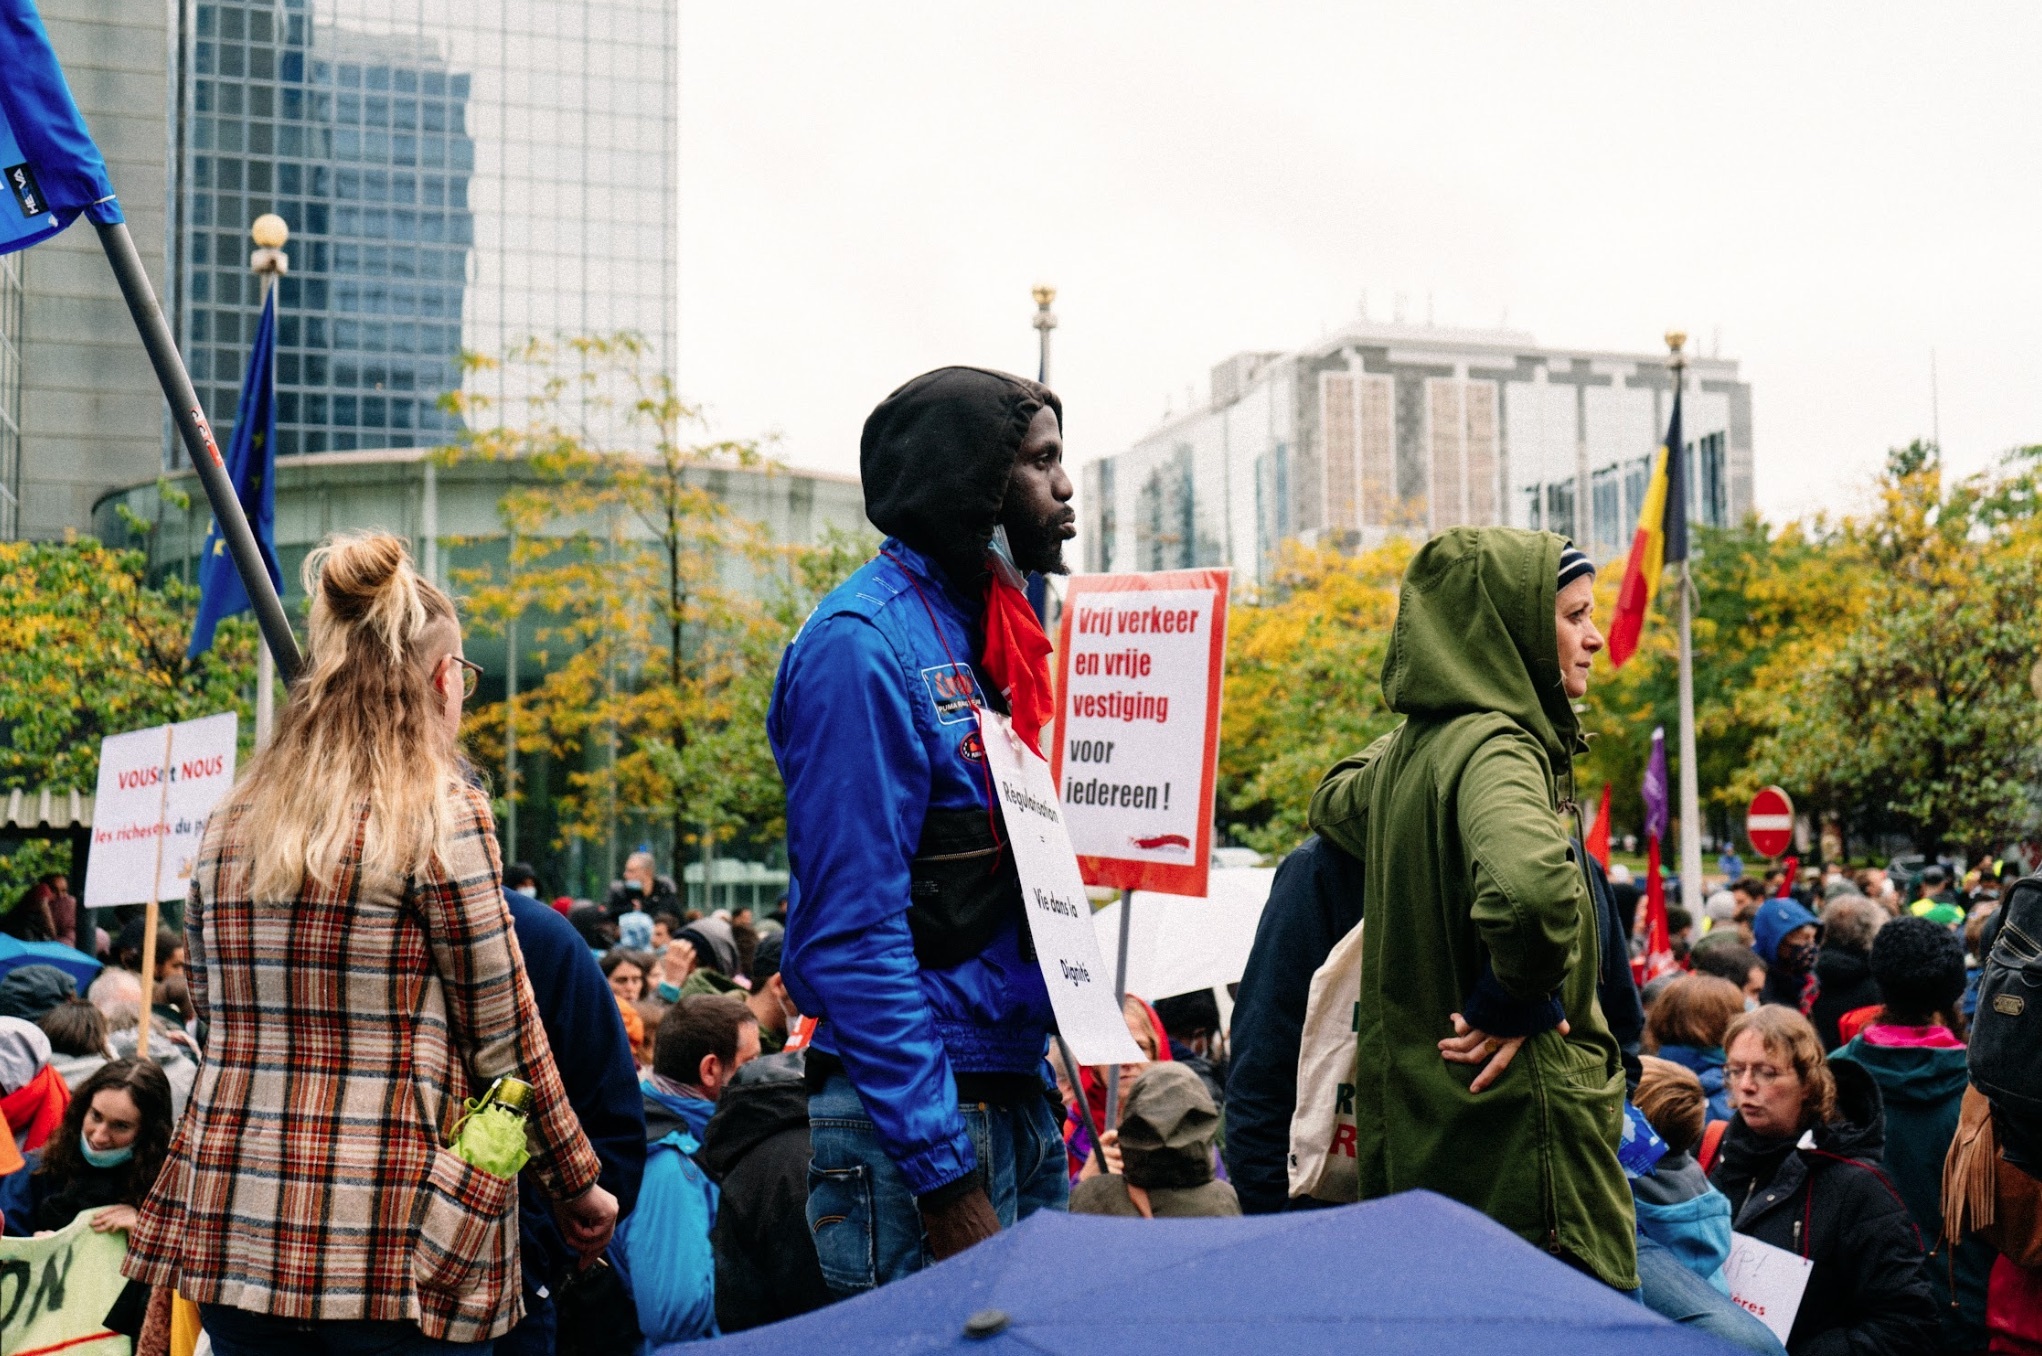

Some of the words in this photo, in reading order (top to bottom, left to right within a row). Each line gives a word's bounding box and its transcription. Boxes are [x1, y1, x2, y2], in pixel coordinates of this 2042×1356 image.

[13, 168, 39, 215] HERVA
[1079, 606, 1114, 637] Vrij
[1117, 605, 1200, 634] verkeer
[1075, 652, 1099, 677] en
[1104, 648, 1152, 679] vrije
[1073, 690, 1170, 724] vestiging
[1070, 739, 1115, 764] voor
[117, 766, 159, 790] VOUS
[181, 755, 224, 781] NOUS
[1002, 780, 1060, 824] Régularisation
[1065, 776, 1158, 810] iedereen
[94, 828, 113, 844] les
[175, 817, 191, 835] du
[1033, 886, 1050, 911] Vie
[1050, 889, 1069, 917] dans
[1066, 894, 1079, 919] la
[1059, 958, 1091, 988] Dignité
